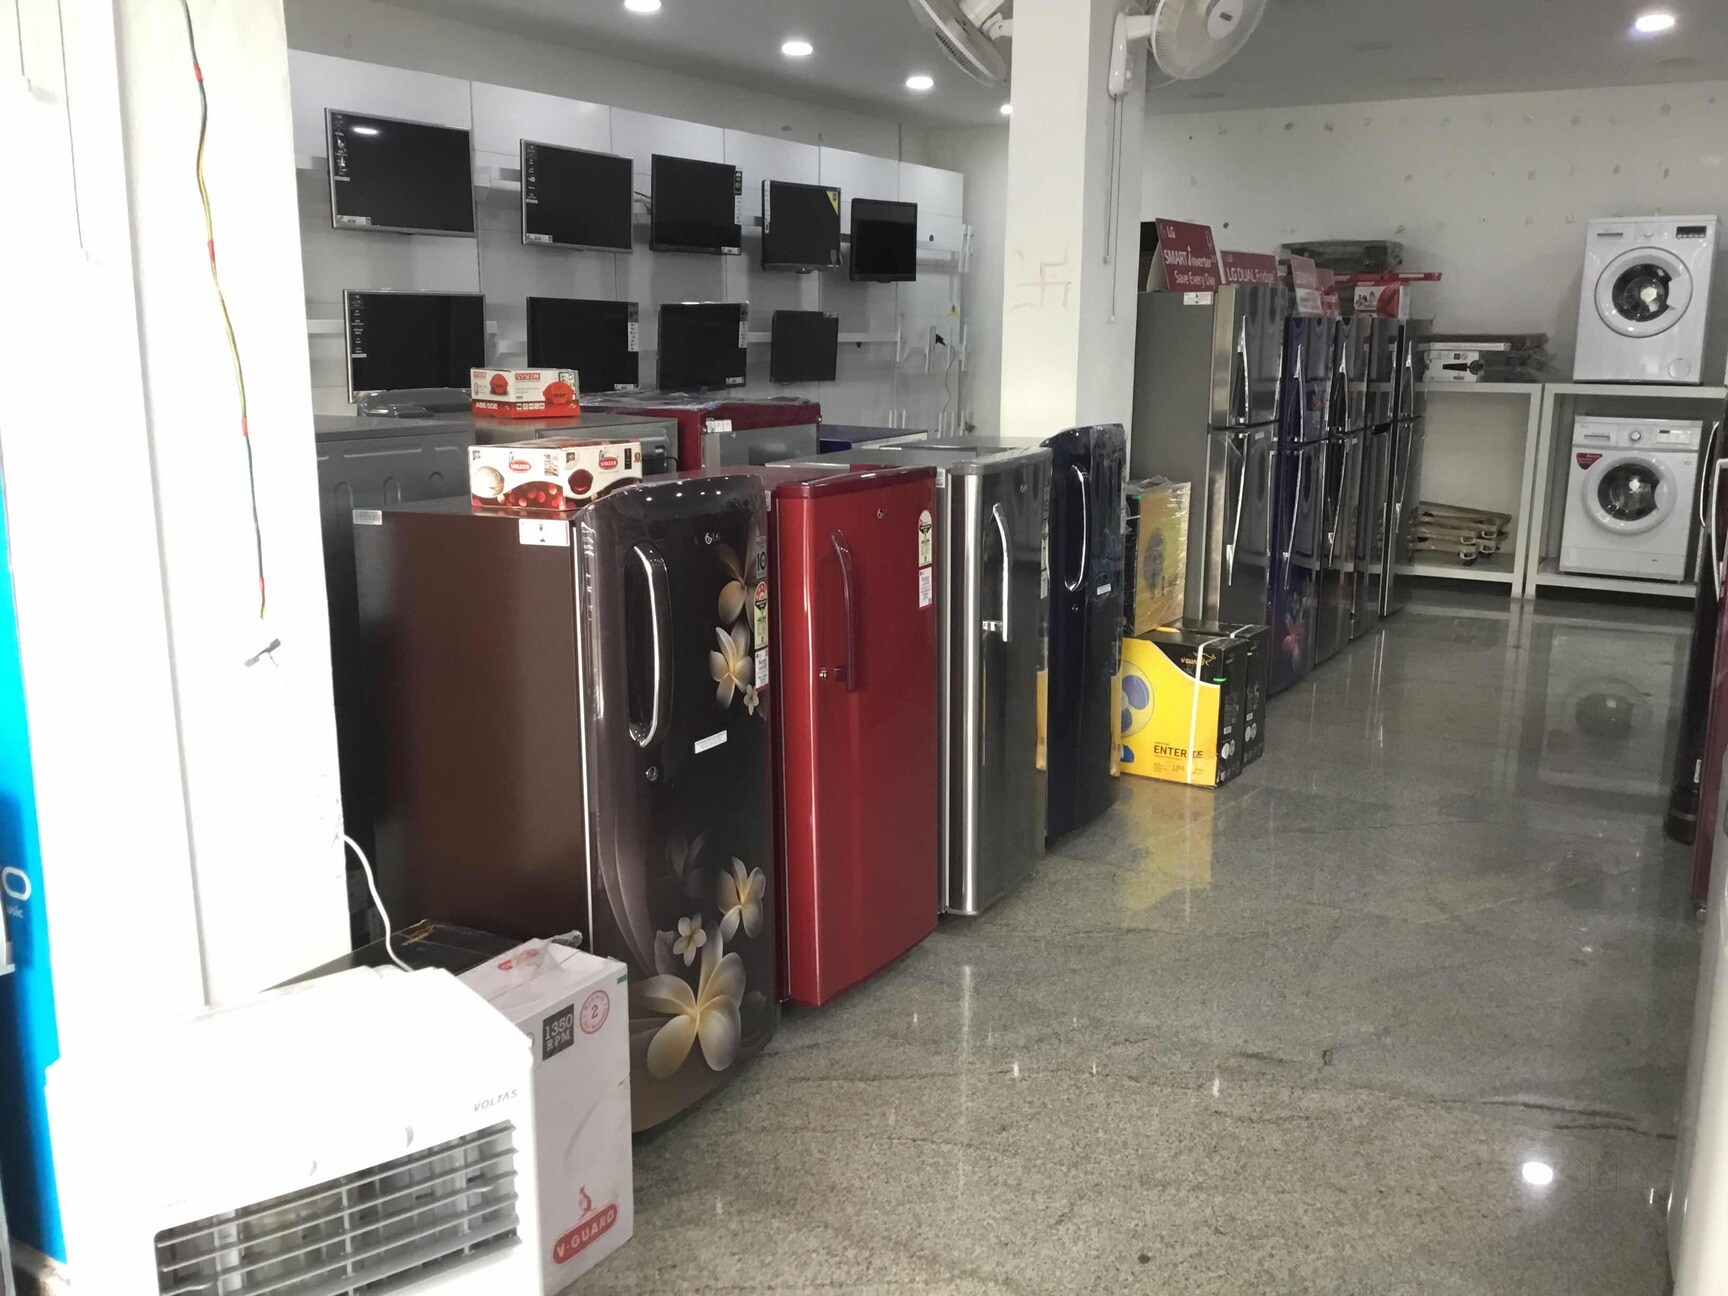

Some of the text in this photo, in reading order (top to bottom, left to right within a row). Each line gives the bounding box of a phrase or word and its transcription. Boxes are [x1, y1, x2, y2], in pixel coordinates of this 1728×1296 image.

[1167, 226, 1176, 239] LG
[1163, 249, 1187, 266] SMART
[1174, 270, 1216, 288] Save Every Day
[1226, 267, 1237, 281] LG
[1237, 268, 1256, 282] DUAL
[591, 1004, 599, 1020] 2
[545, 1013, 573, 1041] 1350
[546, 1029, 571, 1052] RPM
[474, 1088, 518, 1113] VOLTAS
[556, 1208, 615, 1258] V-GUARD
